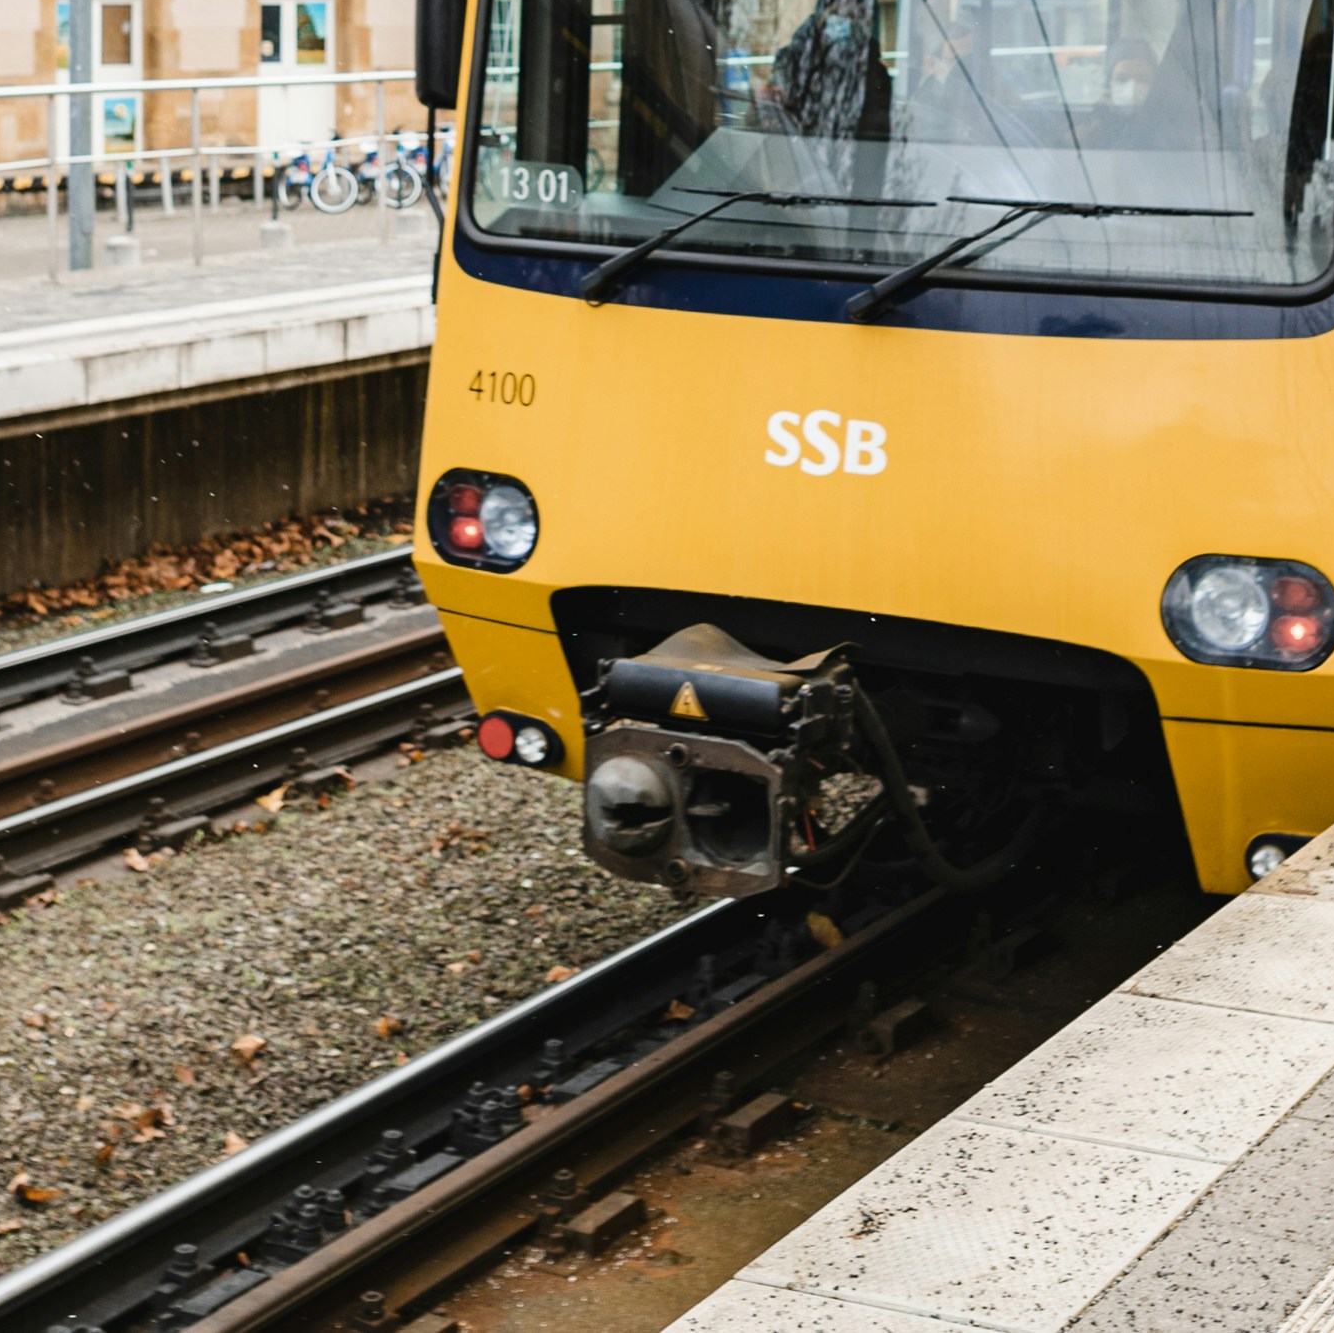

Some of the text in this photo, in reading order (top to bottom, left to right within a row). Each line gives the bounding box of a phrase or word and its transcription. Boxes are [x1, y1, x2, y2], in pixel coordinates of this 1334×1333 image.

[500, 167, 568, 203] 13 01
[468, 370, 536, 407] 4100
[764, 409, 888, 477] SSB
